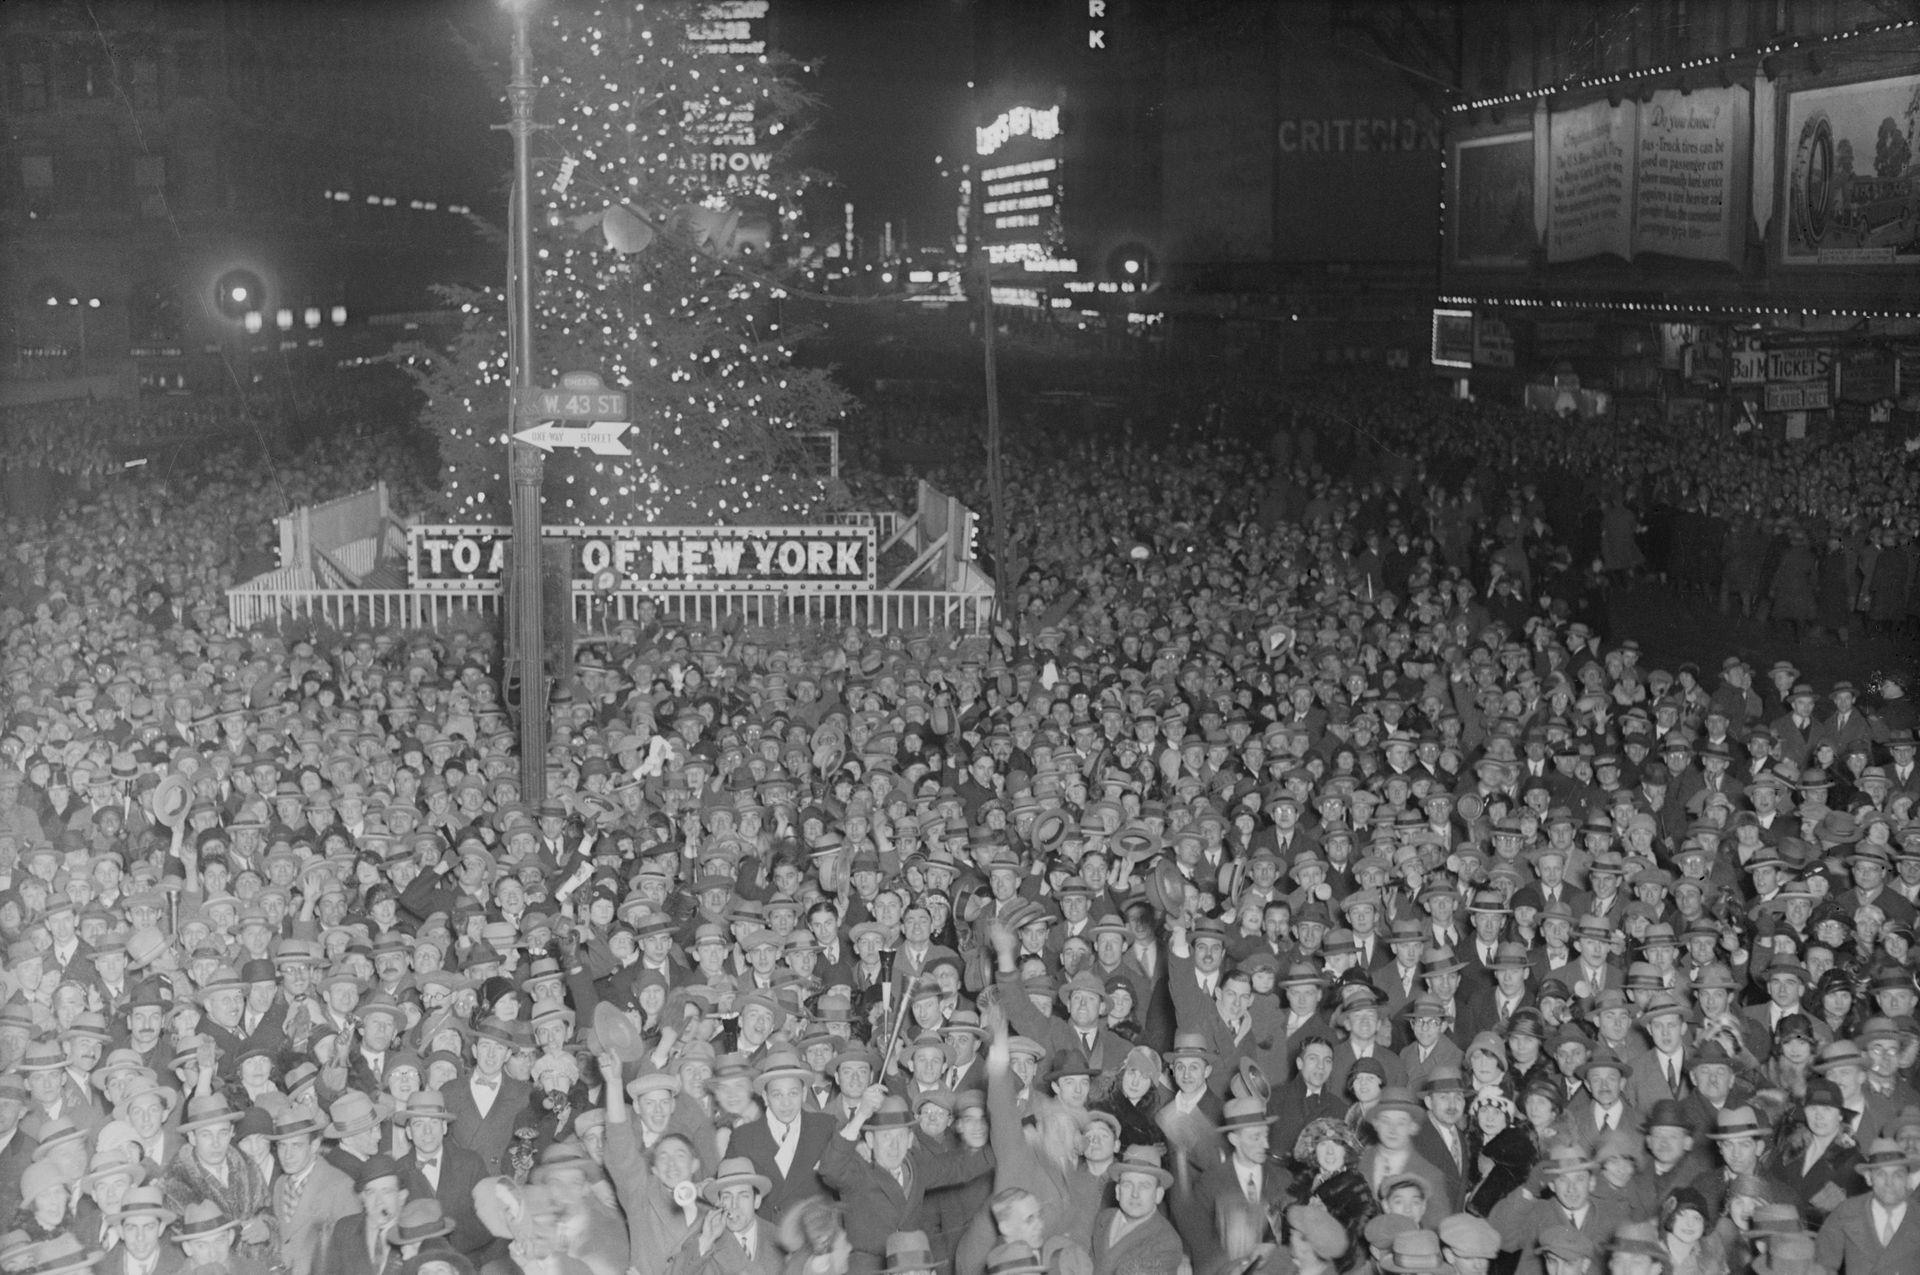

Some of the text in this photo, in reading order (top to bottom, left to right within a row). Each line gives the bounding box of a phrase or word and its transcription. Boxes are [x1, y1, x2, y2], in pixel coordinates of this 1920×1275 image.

[1771, 350, 1832, 377] TICKETS
[544, 395, 622, 414] W. 43 ST.
[579, 432, 612, 444] STREET
[423, 538, 481, 574] TO
[582, 540, 641, 575] OF
[652, 540, 745, 575] NEW
[752, 540, 863, 575] YORK
